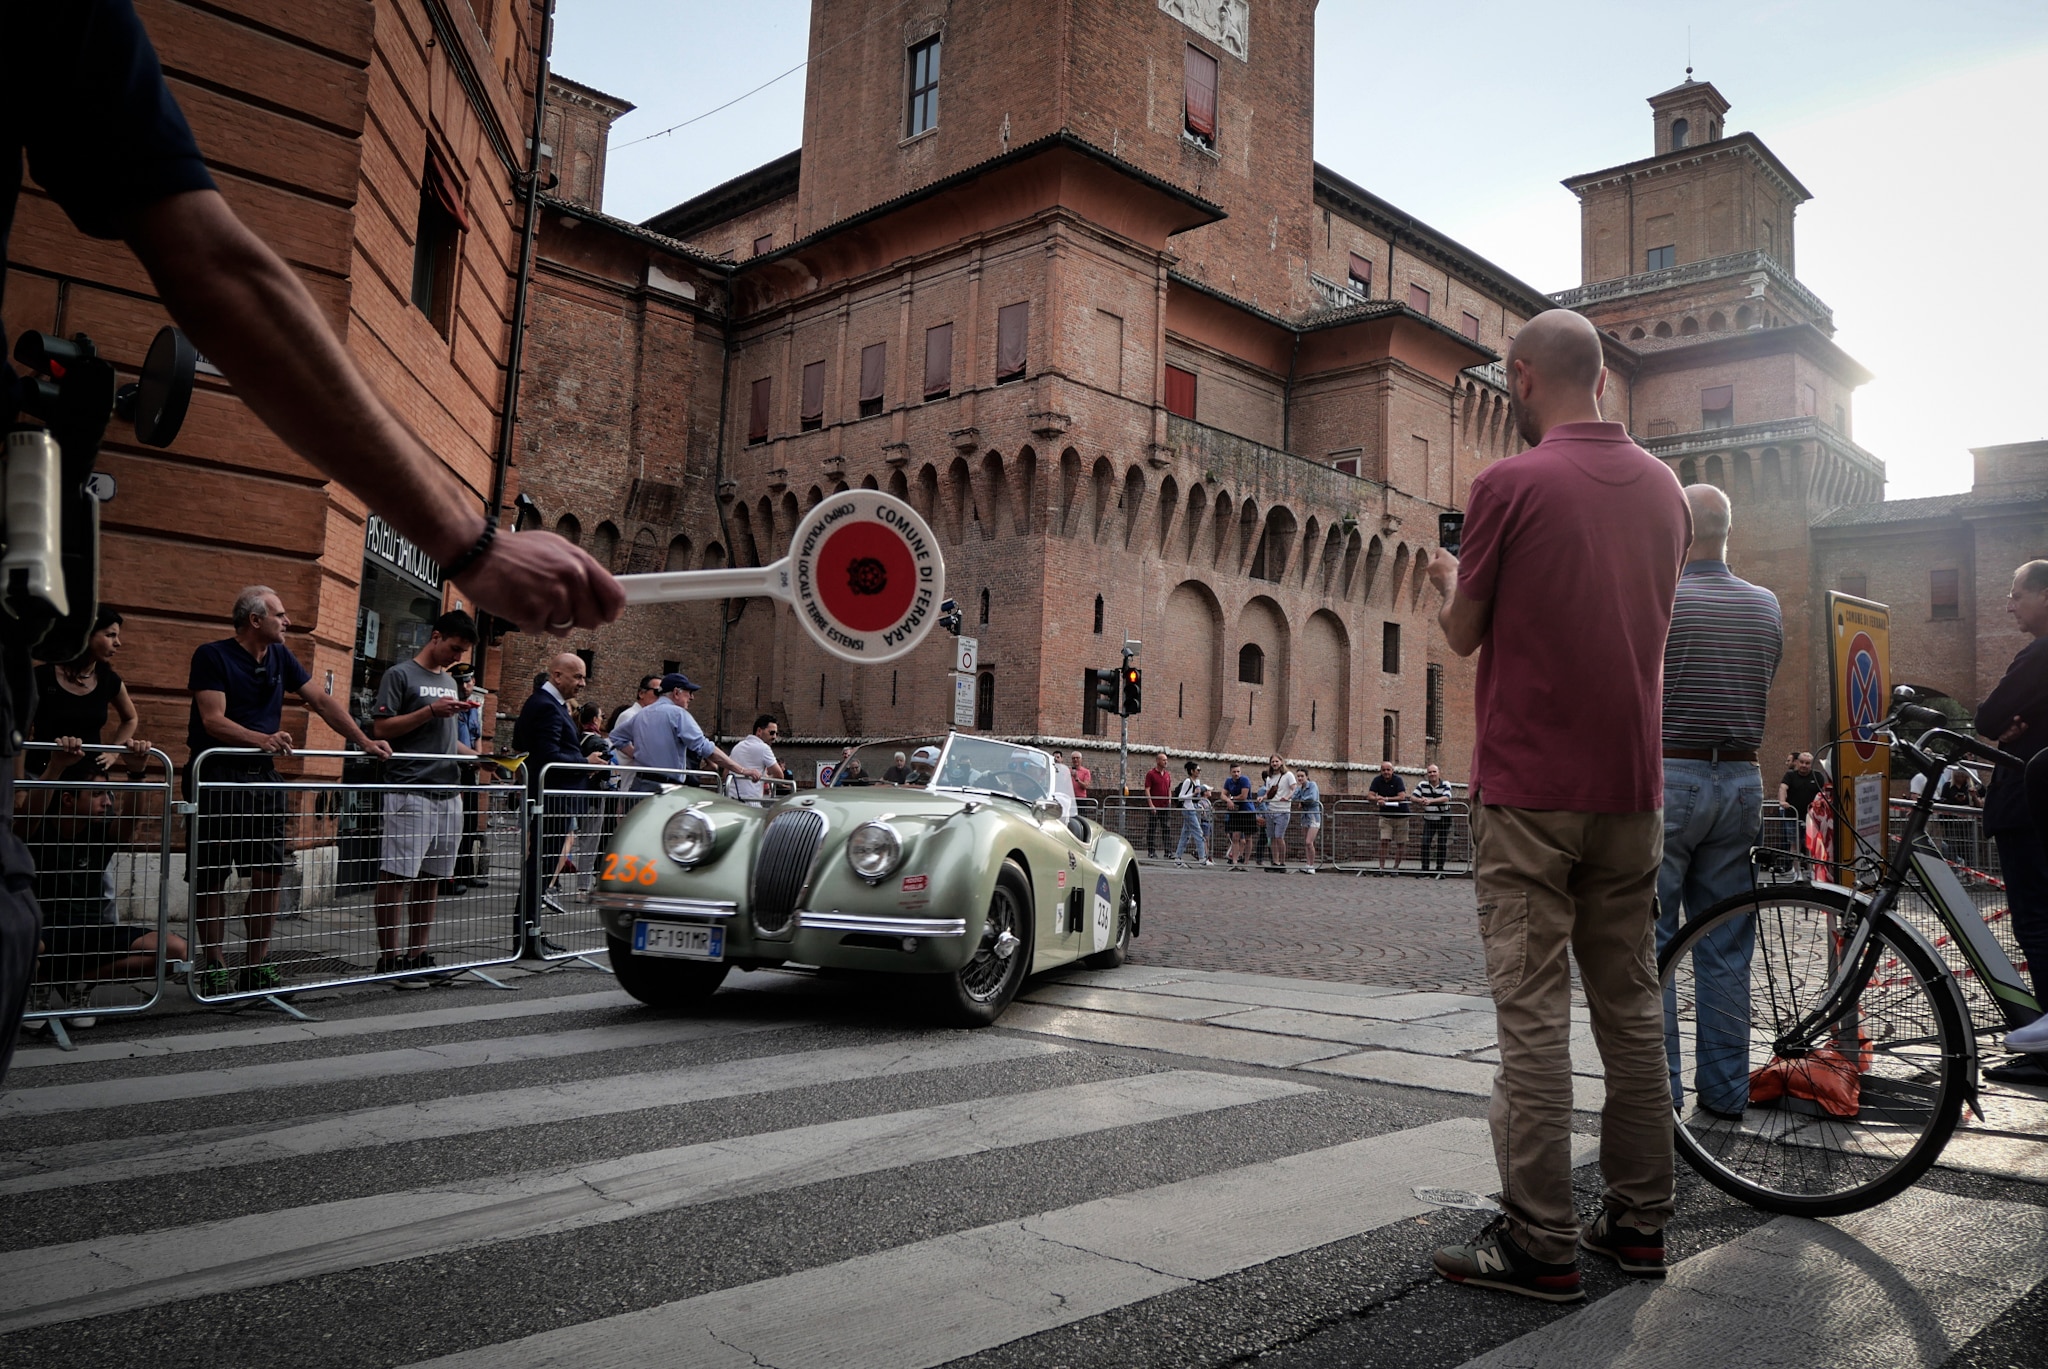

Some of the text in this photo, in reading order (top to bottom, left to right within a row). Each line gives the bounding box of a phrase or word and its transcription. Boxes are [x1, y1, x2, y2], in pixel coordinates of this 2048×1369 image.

[798, 502, 865, 651] CORPO POLIZIA LOCALE TERRE ESTENSI
[876, 504, 933, 647] COMUNE DI FERRARA
[601, 853, 658, 886] 236
[1098, 902, 1108, 930] 236
[1475, 1246, 1505, 1274] N
